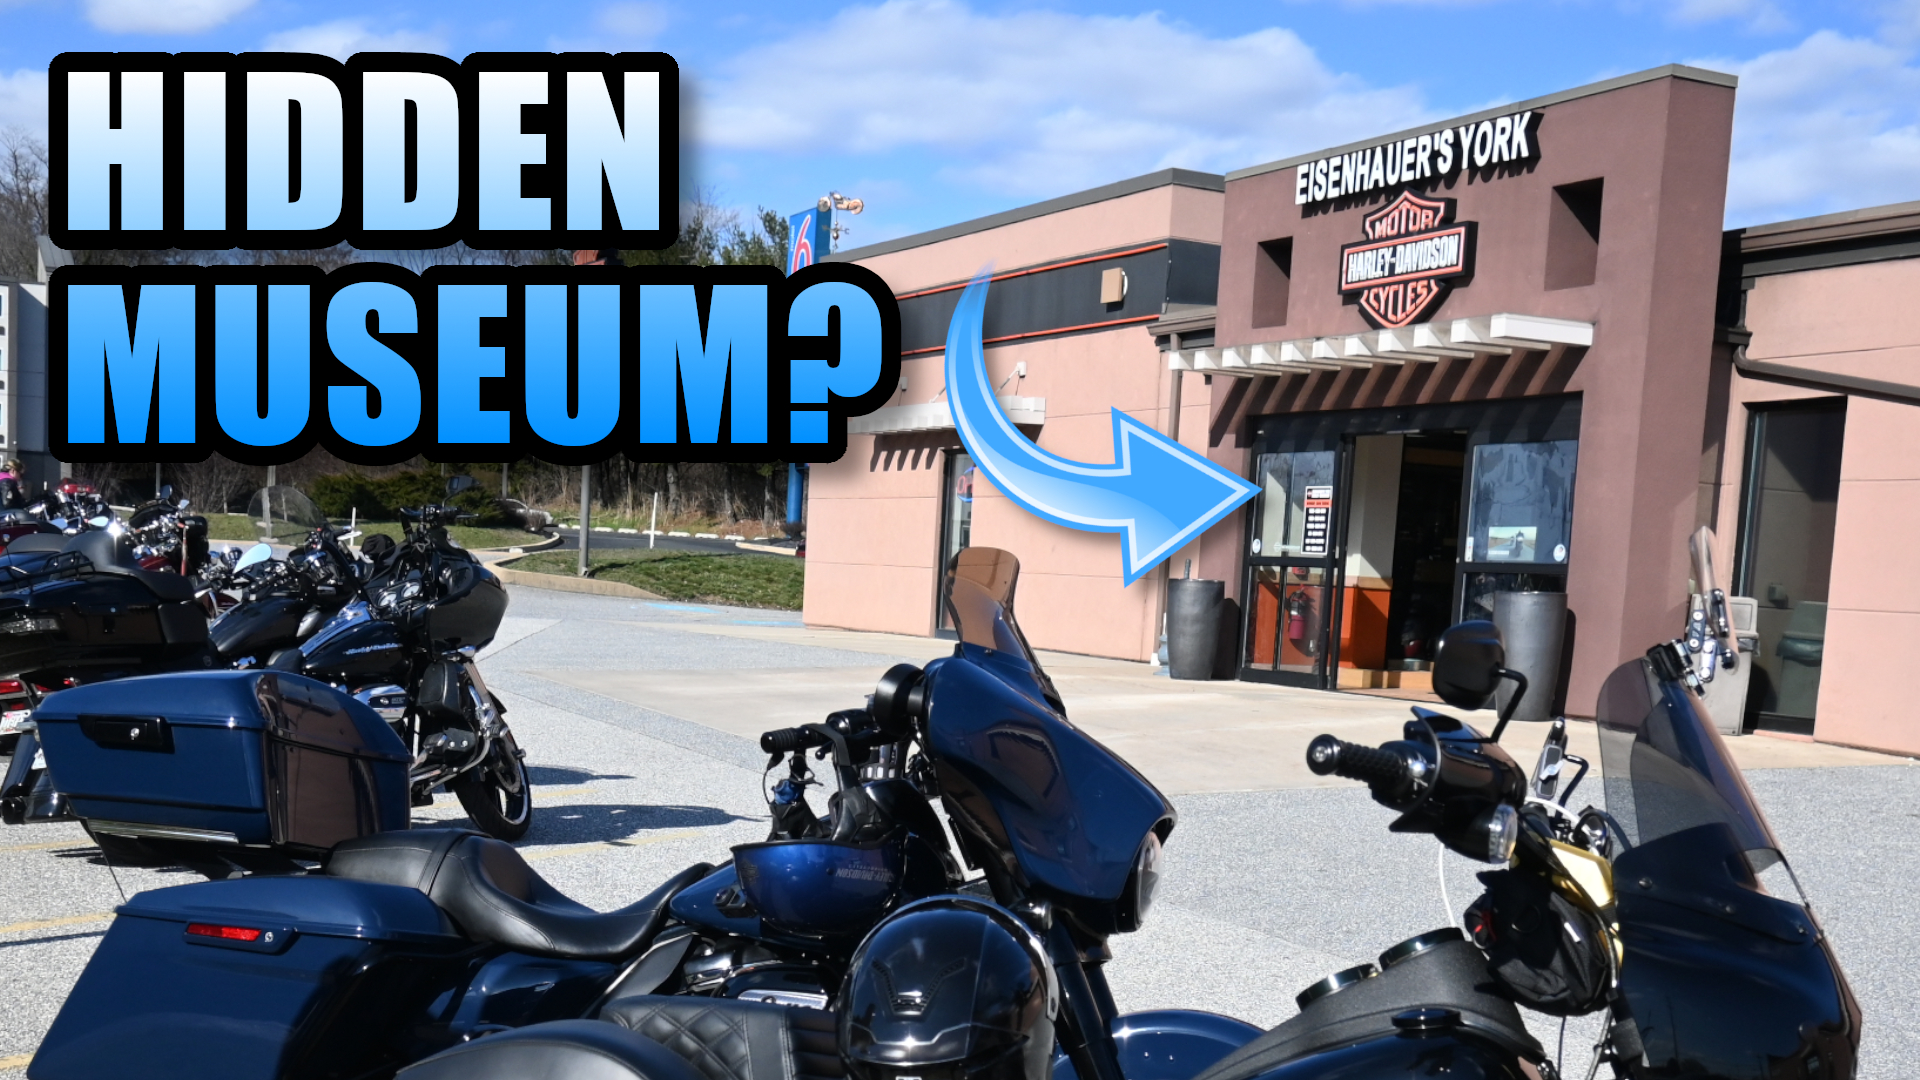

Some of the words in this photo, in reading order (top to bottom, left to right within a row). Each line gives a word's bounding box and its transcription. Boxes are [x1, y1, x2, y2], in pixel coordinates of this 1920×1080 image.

[1294, 128, 1455, 206] EISENHAUER'S
[1458, 110, 1532, 171] YORK
[1374, 200, 1435, 240] MOTOR
[1347, 234, 1460, 283] HARLEY-DAVIDSON
[1368, 279, 1429, 323] CYCLES
